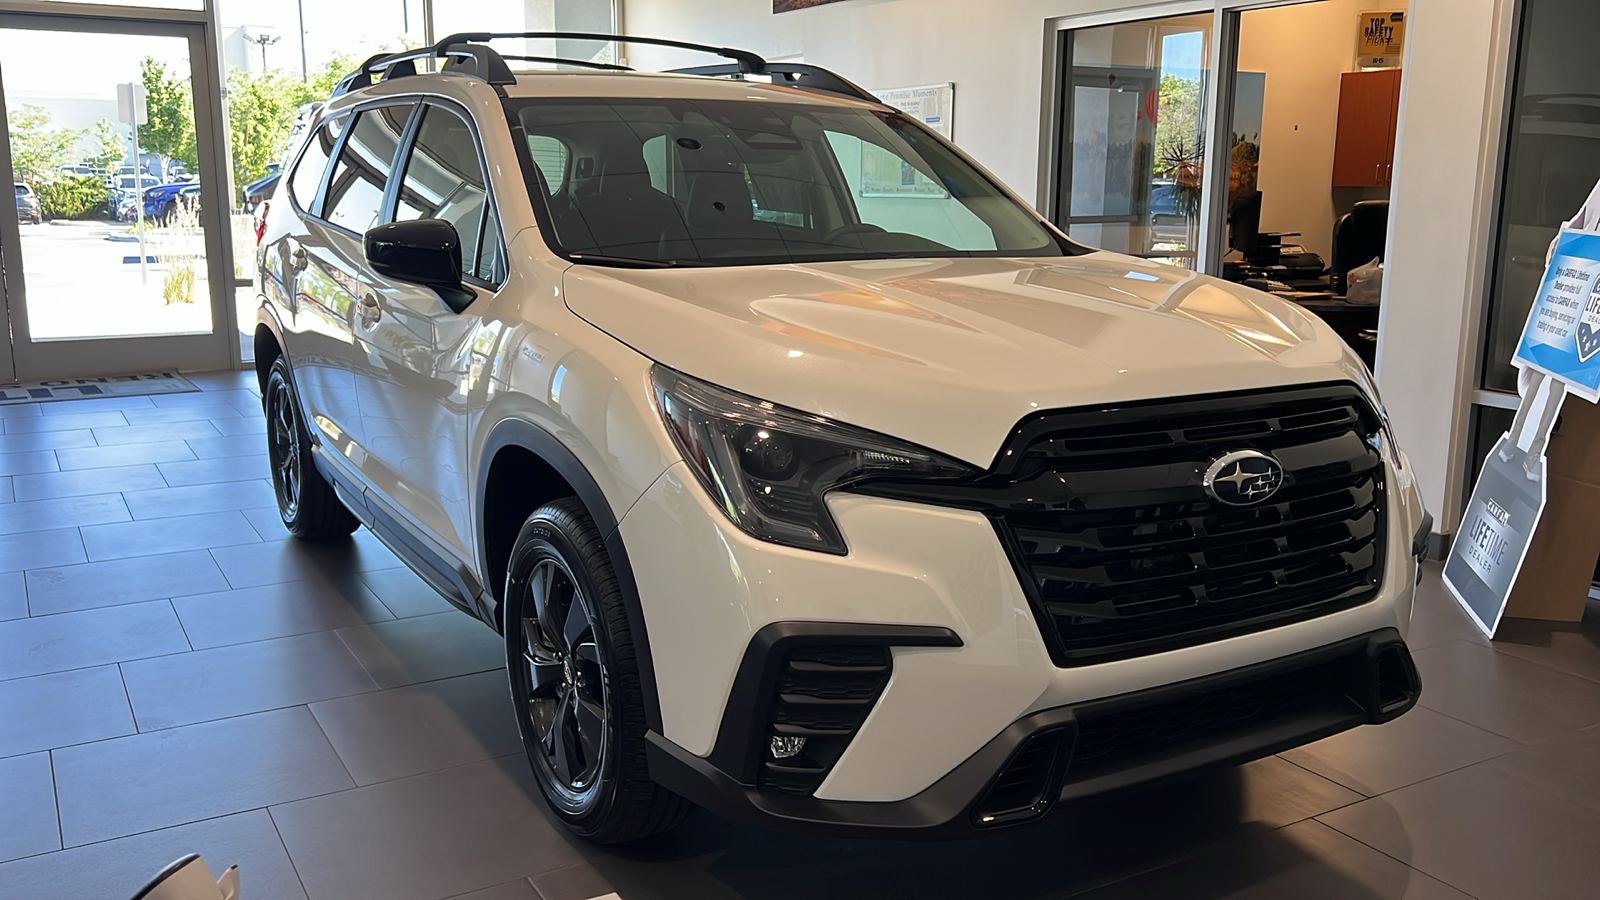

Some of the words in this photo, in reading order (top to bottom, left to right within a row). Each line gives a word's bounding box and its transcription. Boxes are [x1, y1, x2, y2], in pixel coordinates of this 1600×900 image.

[1364, 26, 1394, 37] SAFETY
[1370, 18, 1385, 27] TOP
[1487, 501, 1508, 526] CARFAX
[1469, 515, 1508, 566] LIFETIME
[1468, 545, 1492, 574] DEALER
